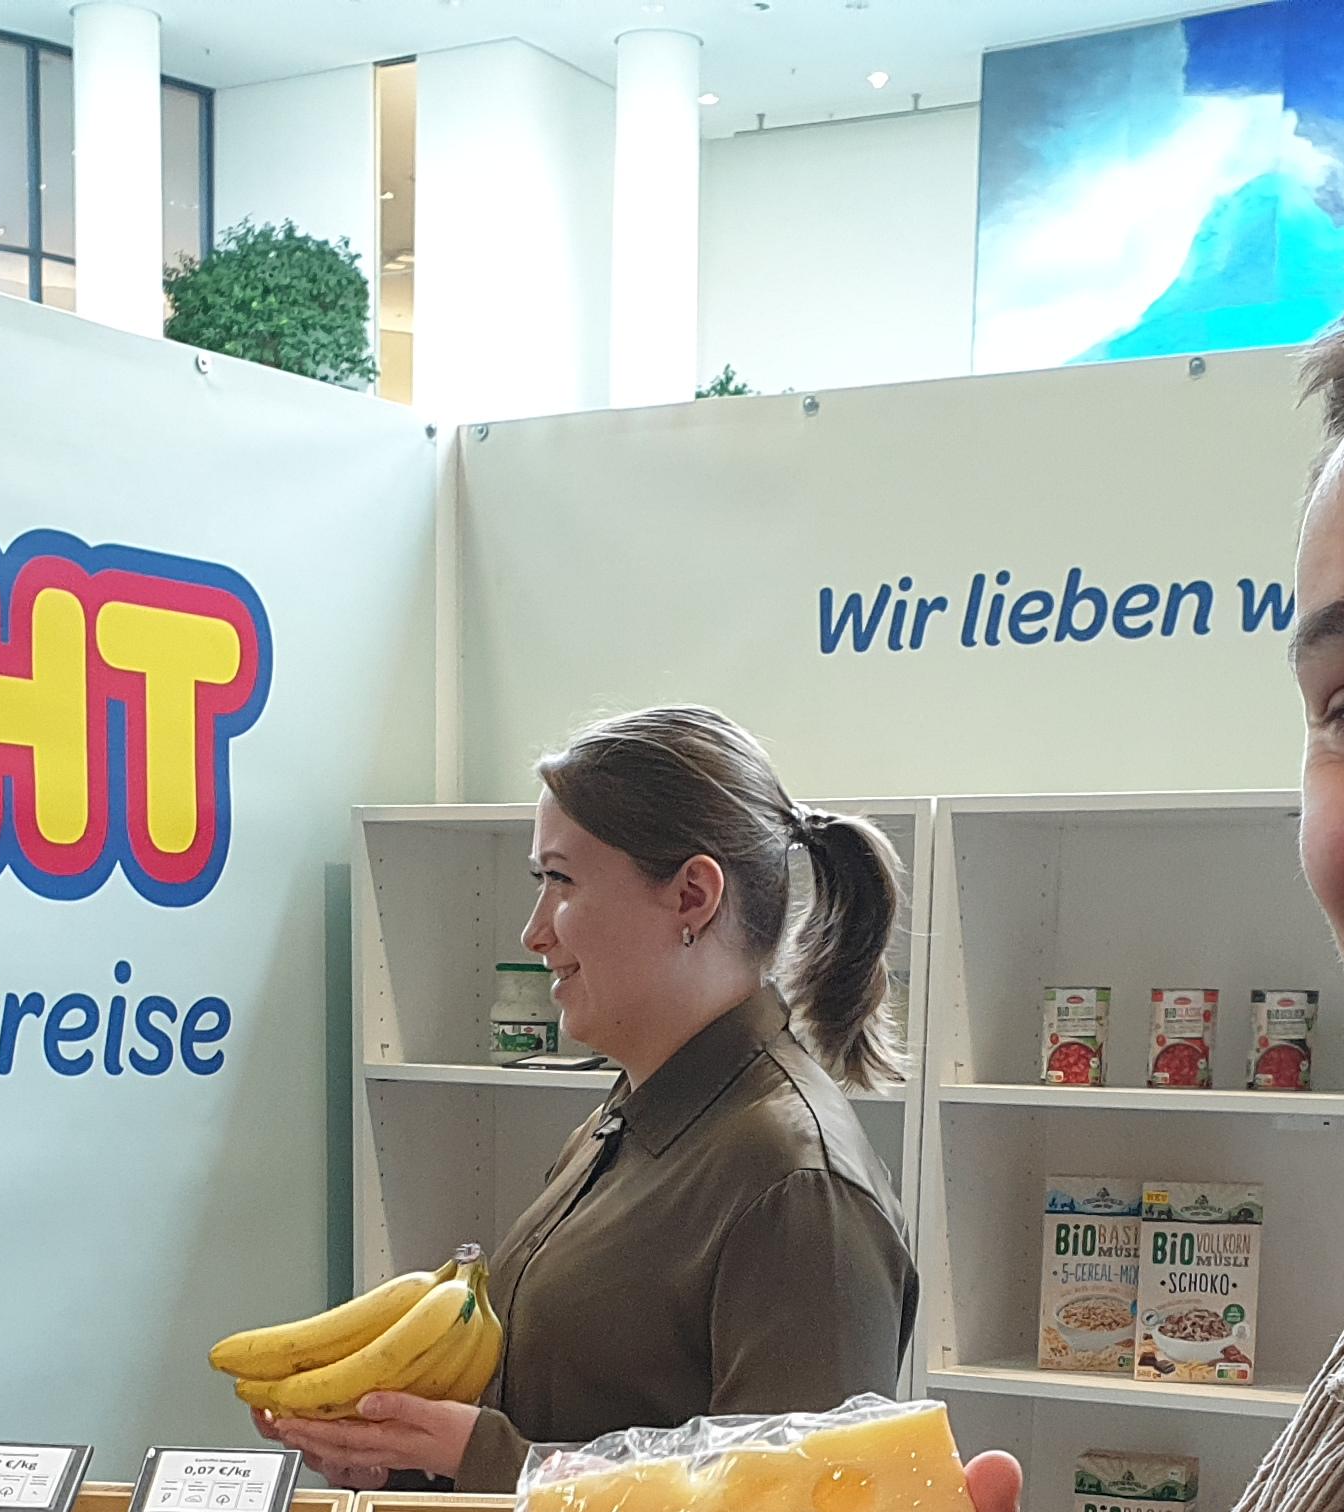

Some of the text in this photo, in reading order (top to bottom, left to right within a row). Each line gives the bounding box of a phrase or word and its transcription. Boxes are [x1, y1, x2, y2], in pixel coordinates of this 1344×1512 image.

[818, 576, 949, 655] Wir
[959, 566, 1215, 648] lieben
[1097, 1223, 1140, 1247] BASI
[1196, 1231, 1251, 1255] VOLLKORN
[1168, 1271, 1230, 1296] SCHOKO
[5, 1459, 38, 1471] €/kg
[184, 1465, 252, 1478] 0,07 €/kg
